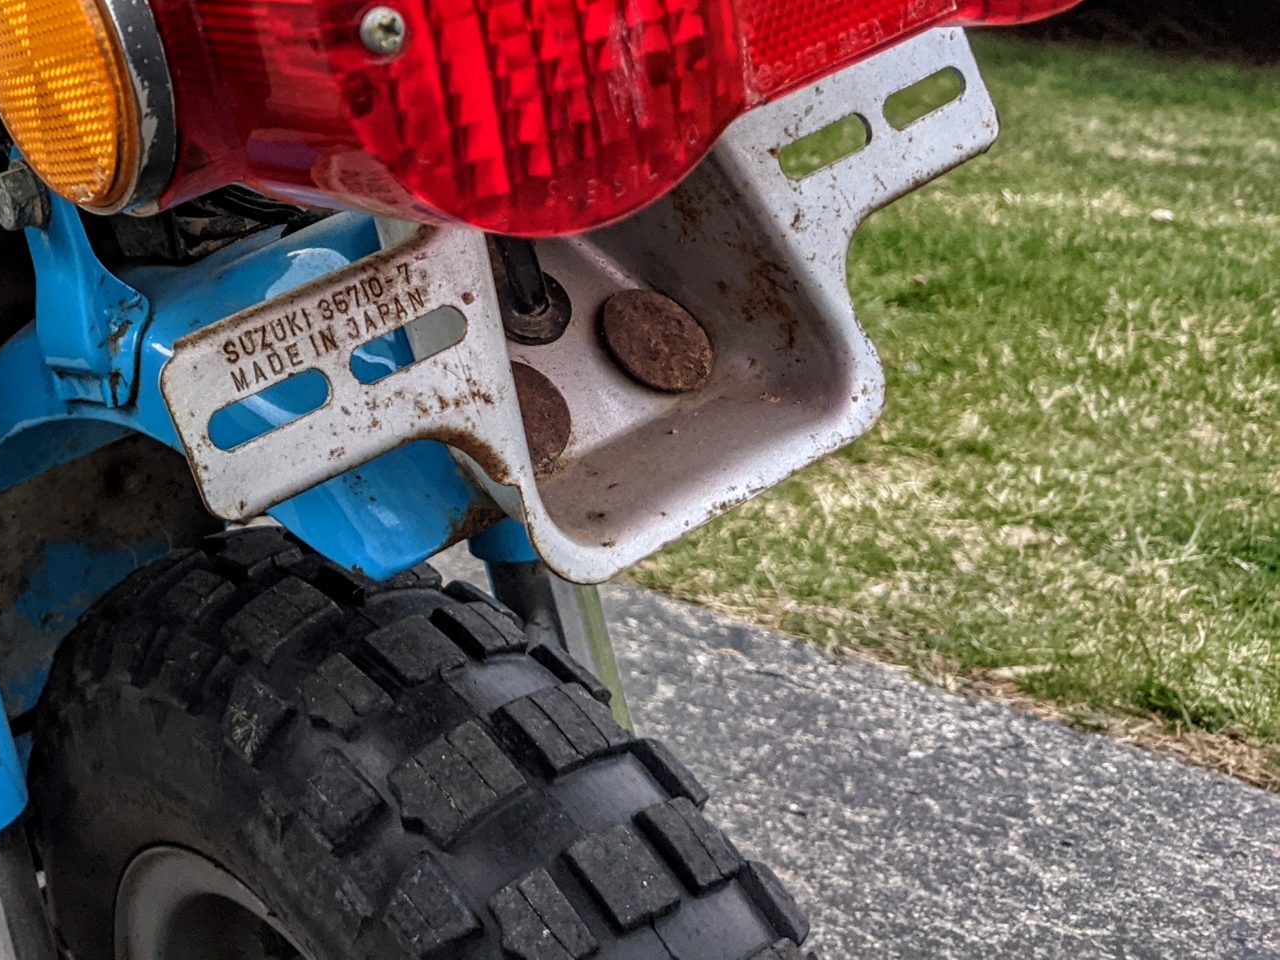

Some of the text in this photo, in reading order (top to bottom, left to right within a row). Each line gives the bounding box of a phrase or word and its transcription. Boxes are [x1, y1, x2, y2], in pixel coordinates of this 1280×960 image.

[223, 307, 313, 364] SUZUKI
[230, 288, 426, 393] MADE IN JAPAN
